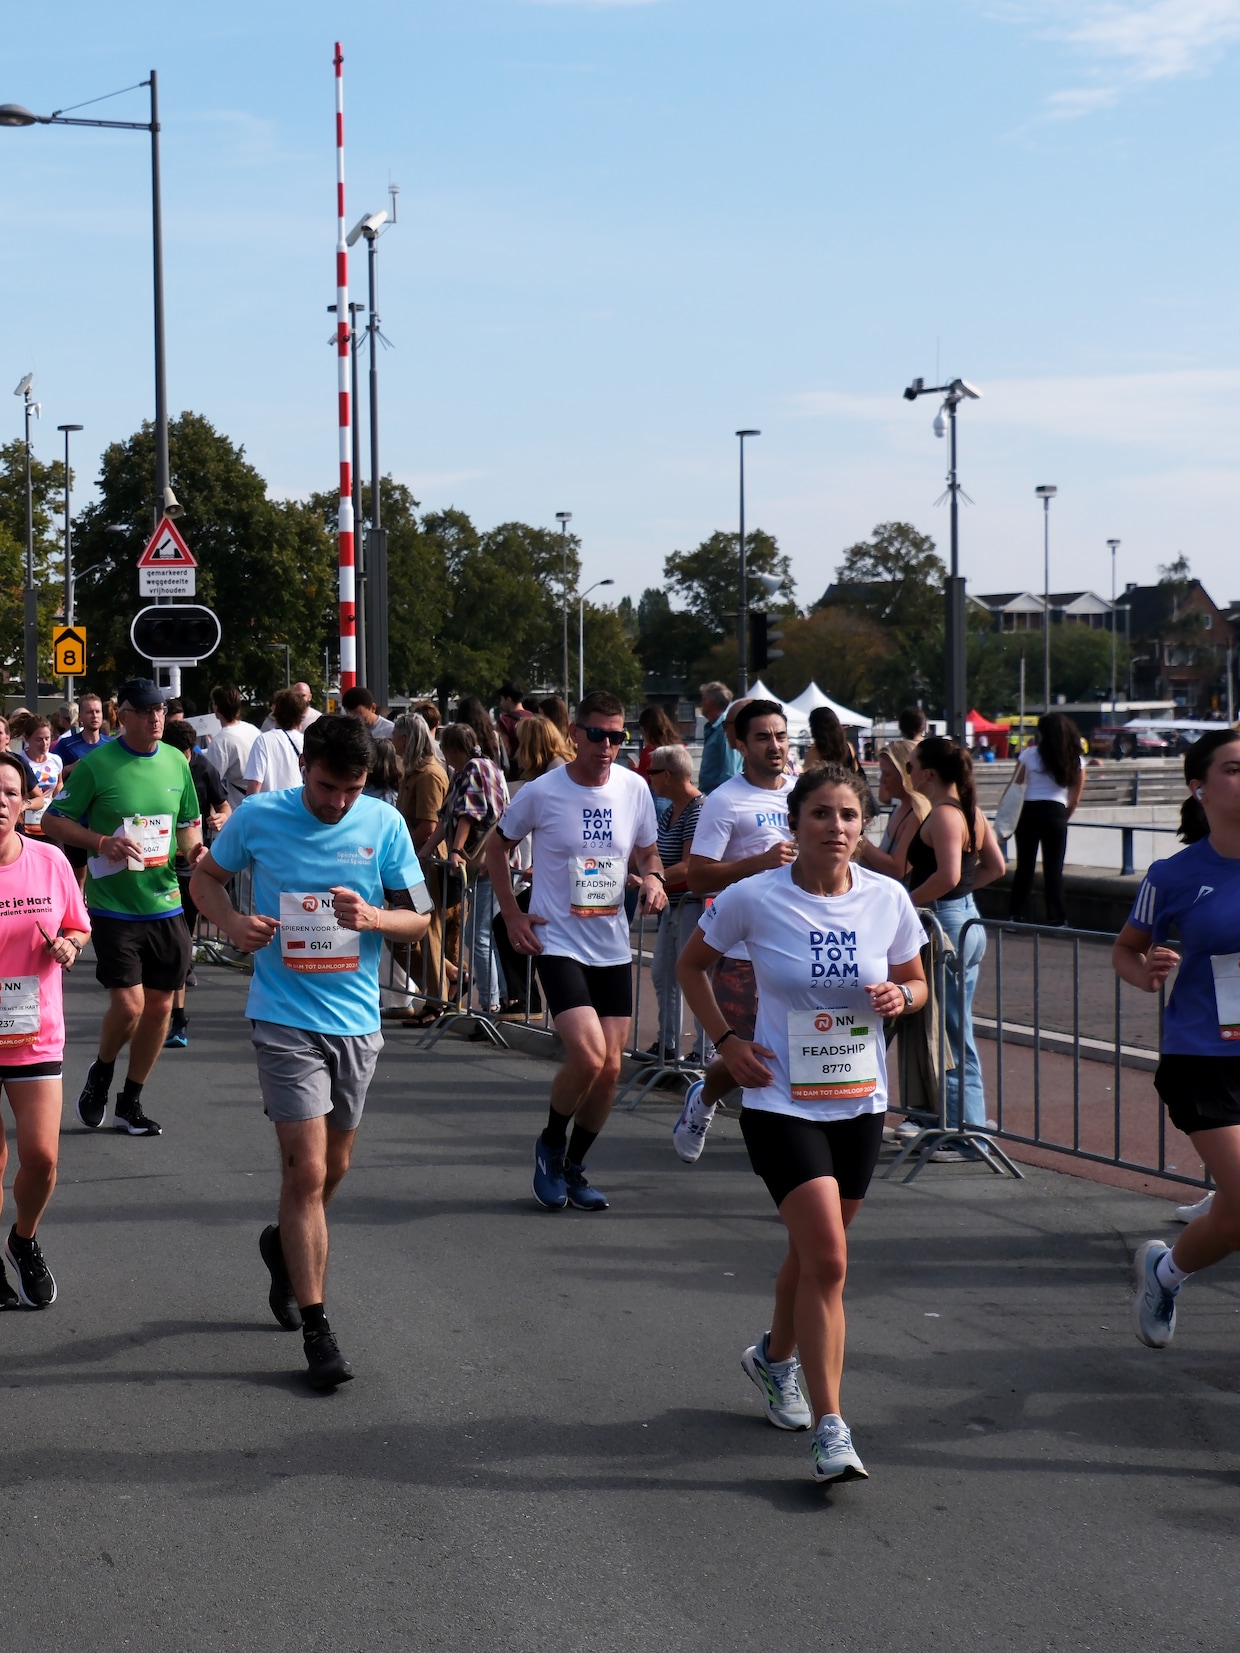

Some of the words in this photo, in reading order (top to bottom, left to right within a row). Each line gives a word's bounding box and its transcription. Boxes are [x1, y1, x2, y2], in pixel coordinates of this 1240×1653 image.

[64, 650, 76, 666] 8
[583, 808, 612, 818] DAM
[583, 820, 612, 829] TOT
[756, 813, 788, 826] PHIL
[583, 831, 612, 840] DAM
[13, 898, 24, 908] je
[26, 896, 52, 906] Hart
[810, 931, 856, 945] DAM
[810, 948, 856, 961] TOT
[811, 963, 859, 978] DAM
[810, 979, 859, 989] 2024
[835, 1016, 854, 1026] NN
[802, 1044, 865, 1056] FEADSHIP
[822, 1063, 852, 1074] 8770
